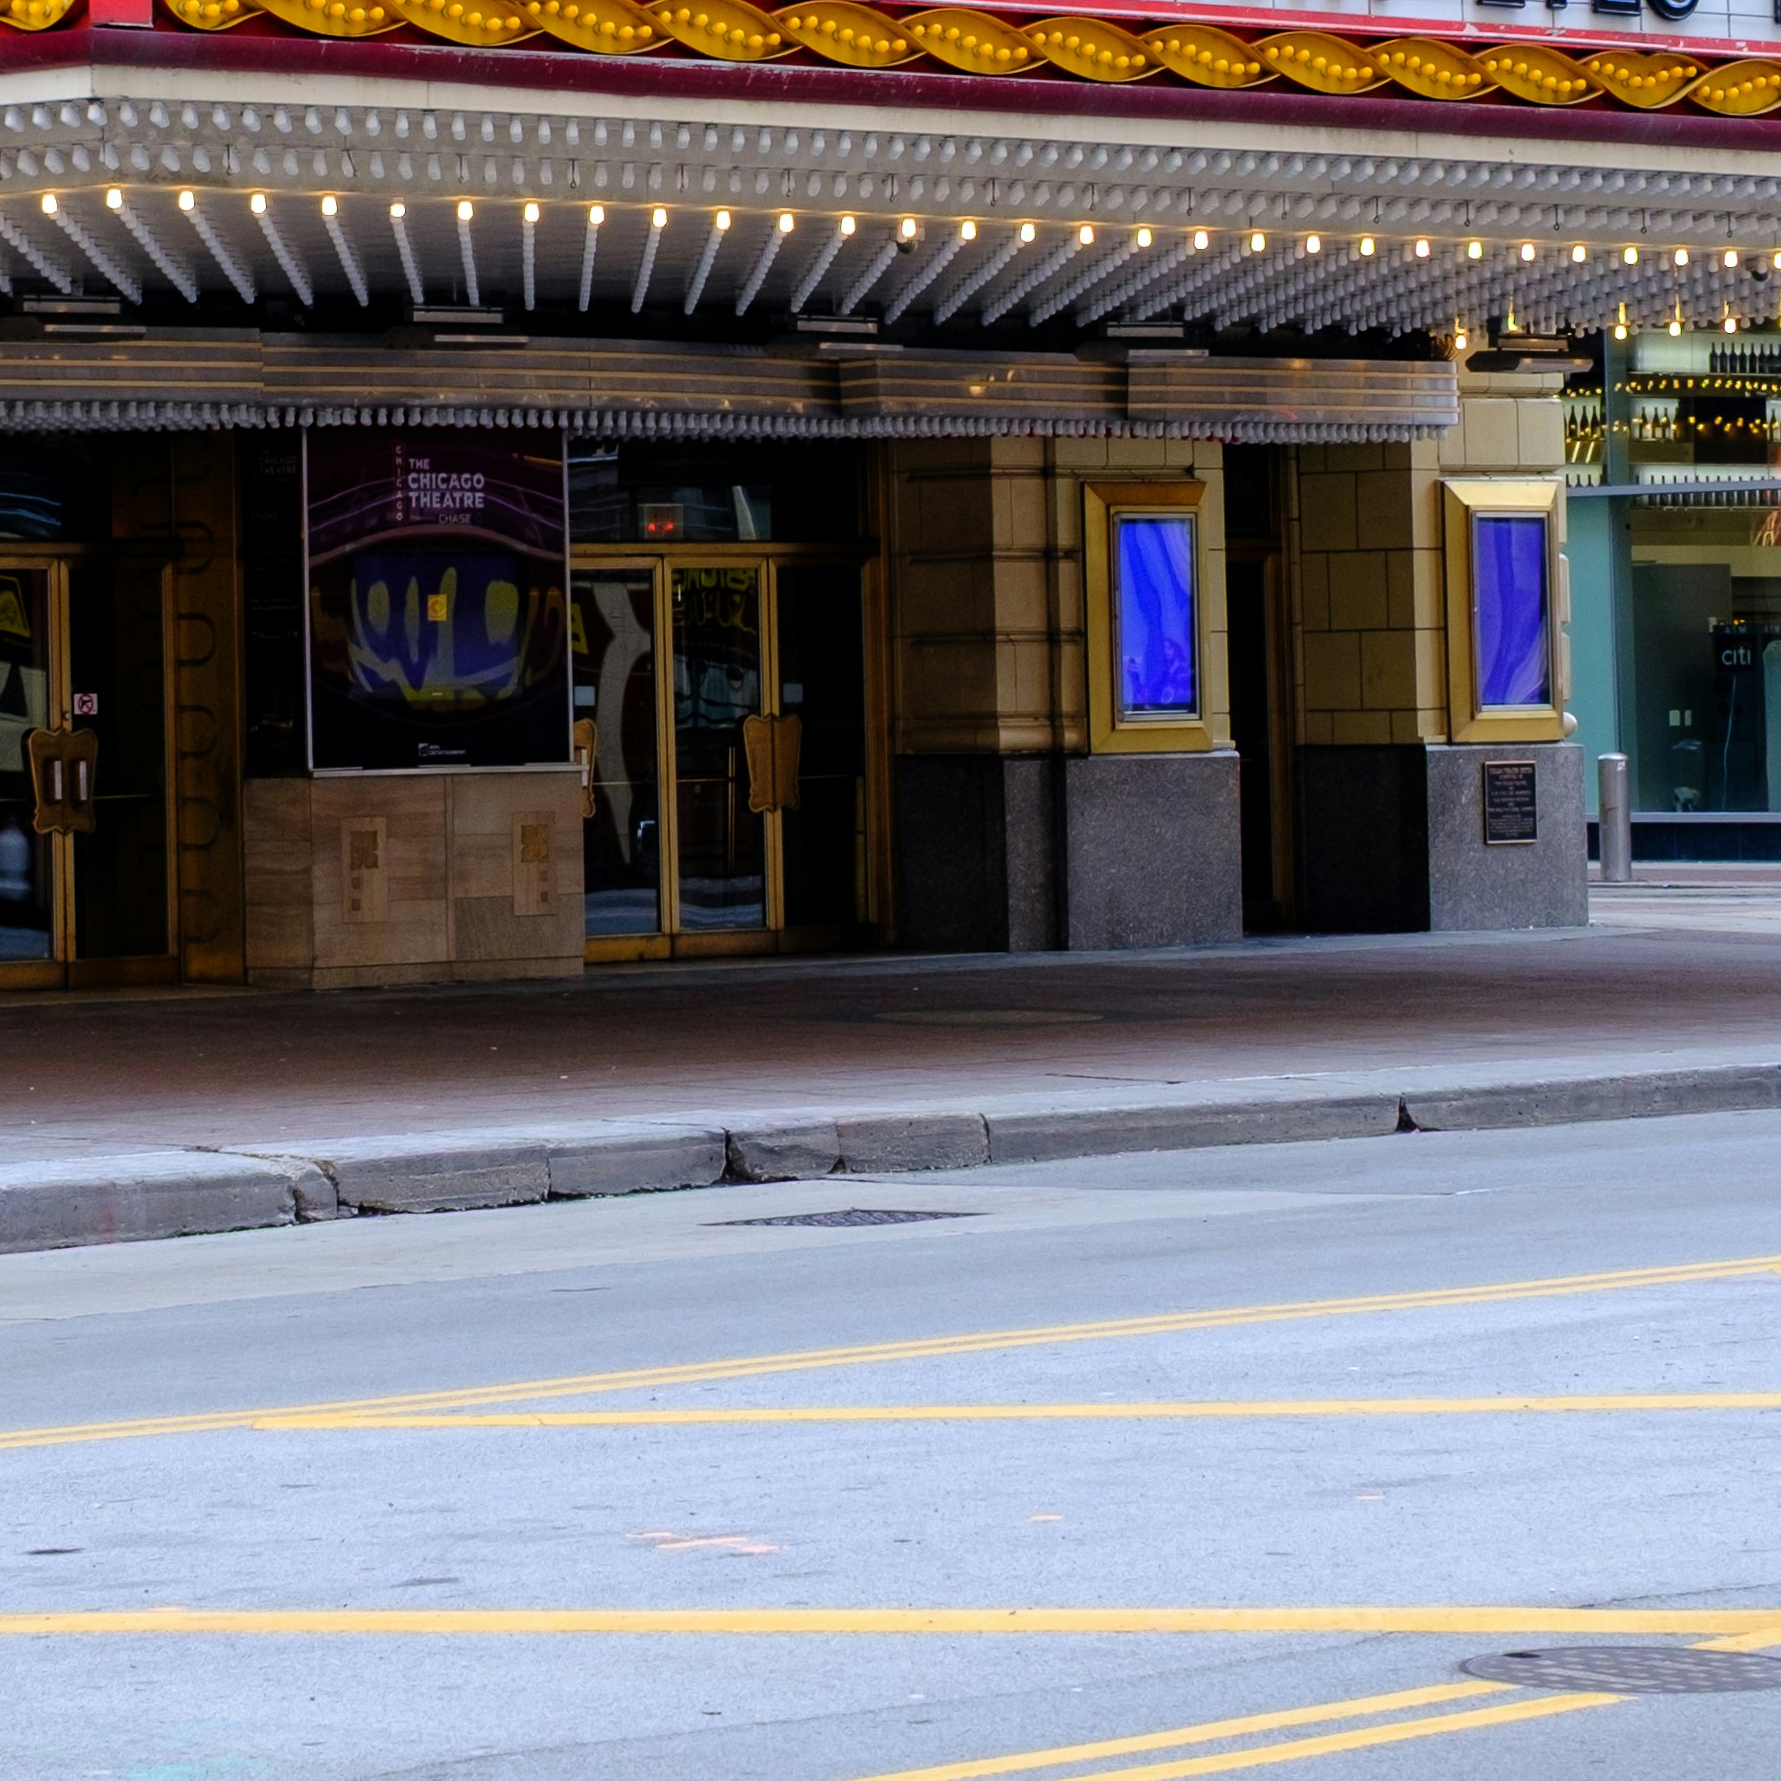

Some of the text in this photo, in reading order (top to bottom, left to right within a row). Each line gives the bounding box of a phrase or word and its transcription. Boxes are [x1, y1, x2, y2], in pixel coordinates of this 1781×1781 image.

[408, 458, 430, 469] THE
[407, 472, 485, 489] CHICAGO
[408, 491, 485, 508] THEATRE
[438, 513, 472, 524] CHASE
[1721, 646, 1751, 665] citi
